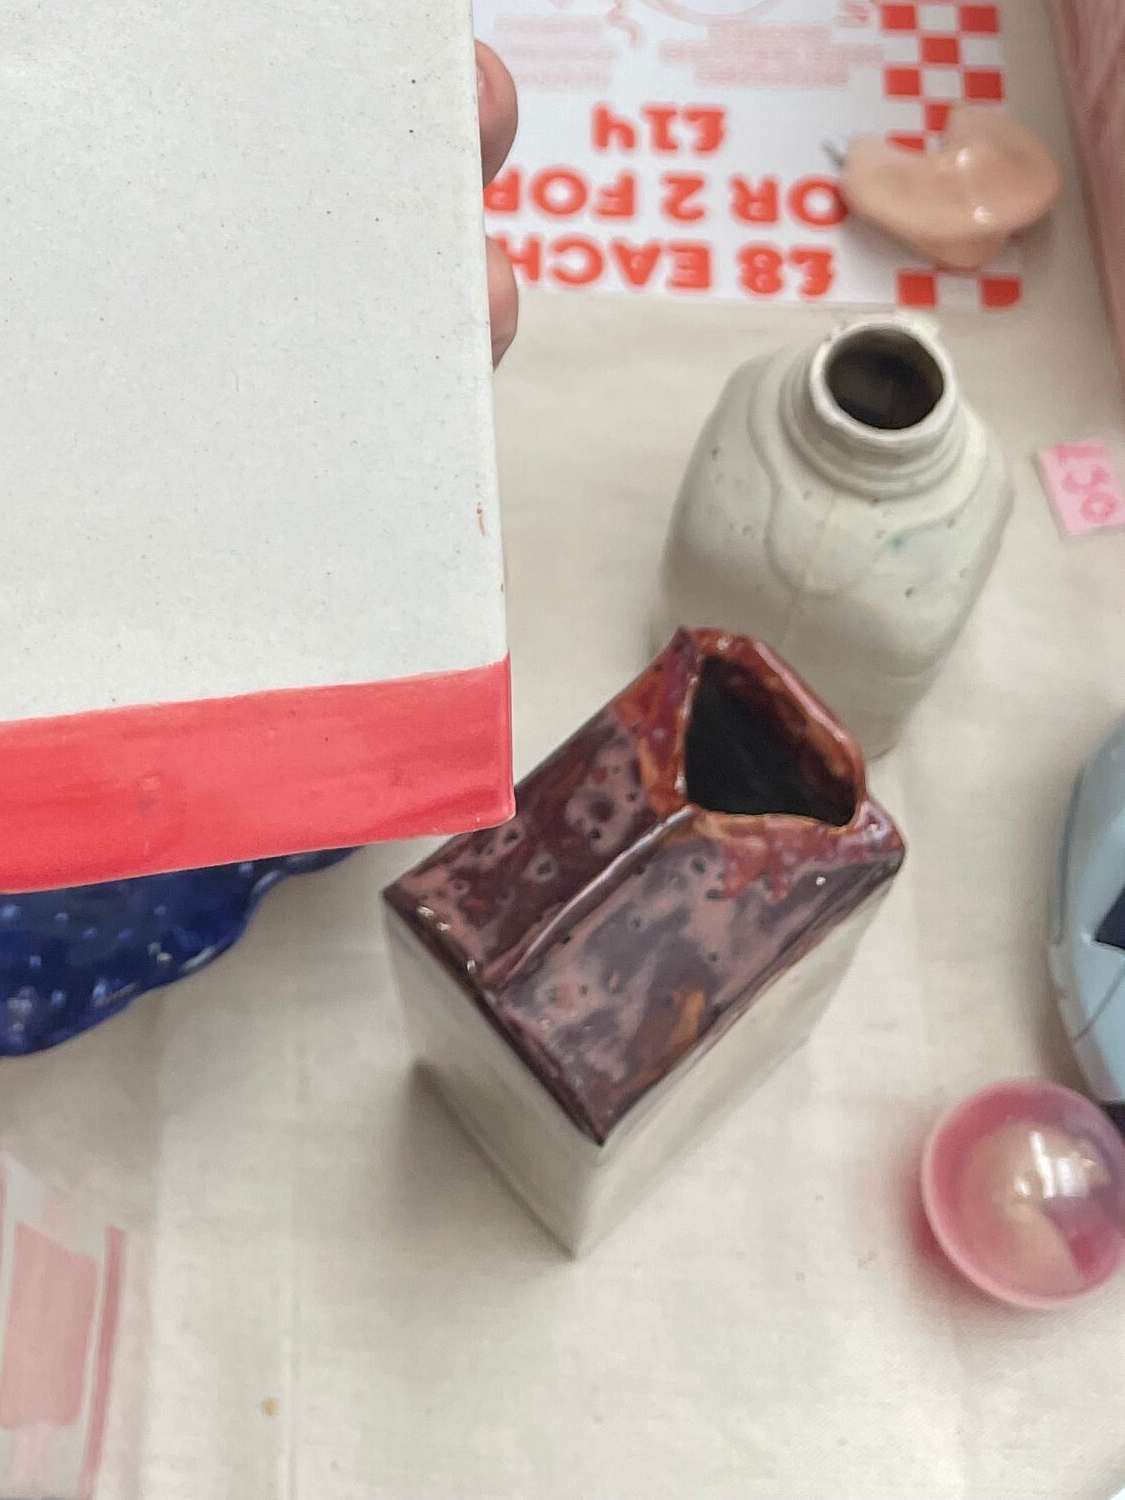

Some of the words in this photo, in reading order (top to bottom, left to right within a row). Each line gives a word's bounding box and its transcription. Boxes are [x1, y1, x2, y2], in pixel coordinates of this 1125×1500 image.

[592, 103, 727, 155] £14
[661, 173, 706, 221] 2
[730, 174, 849, 226] OR
[496, 233, 712, 290] EACH
[737, 240, 836, 299] £8
